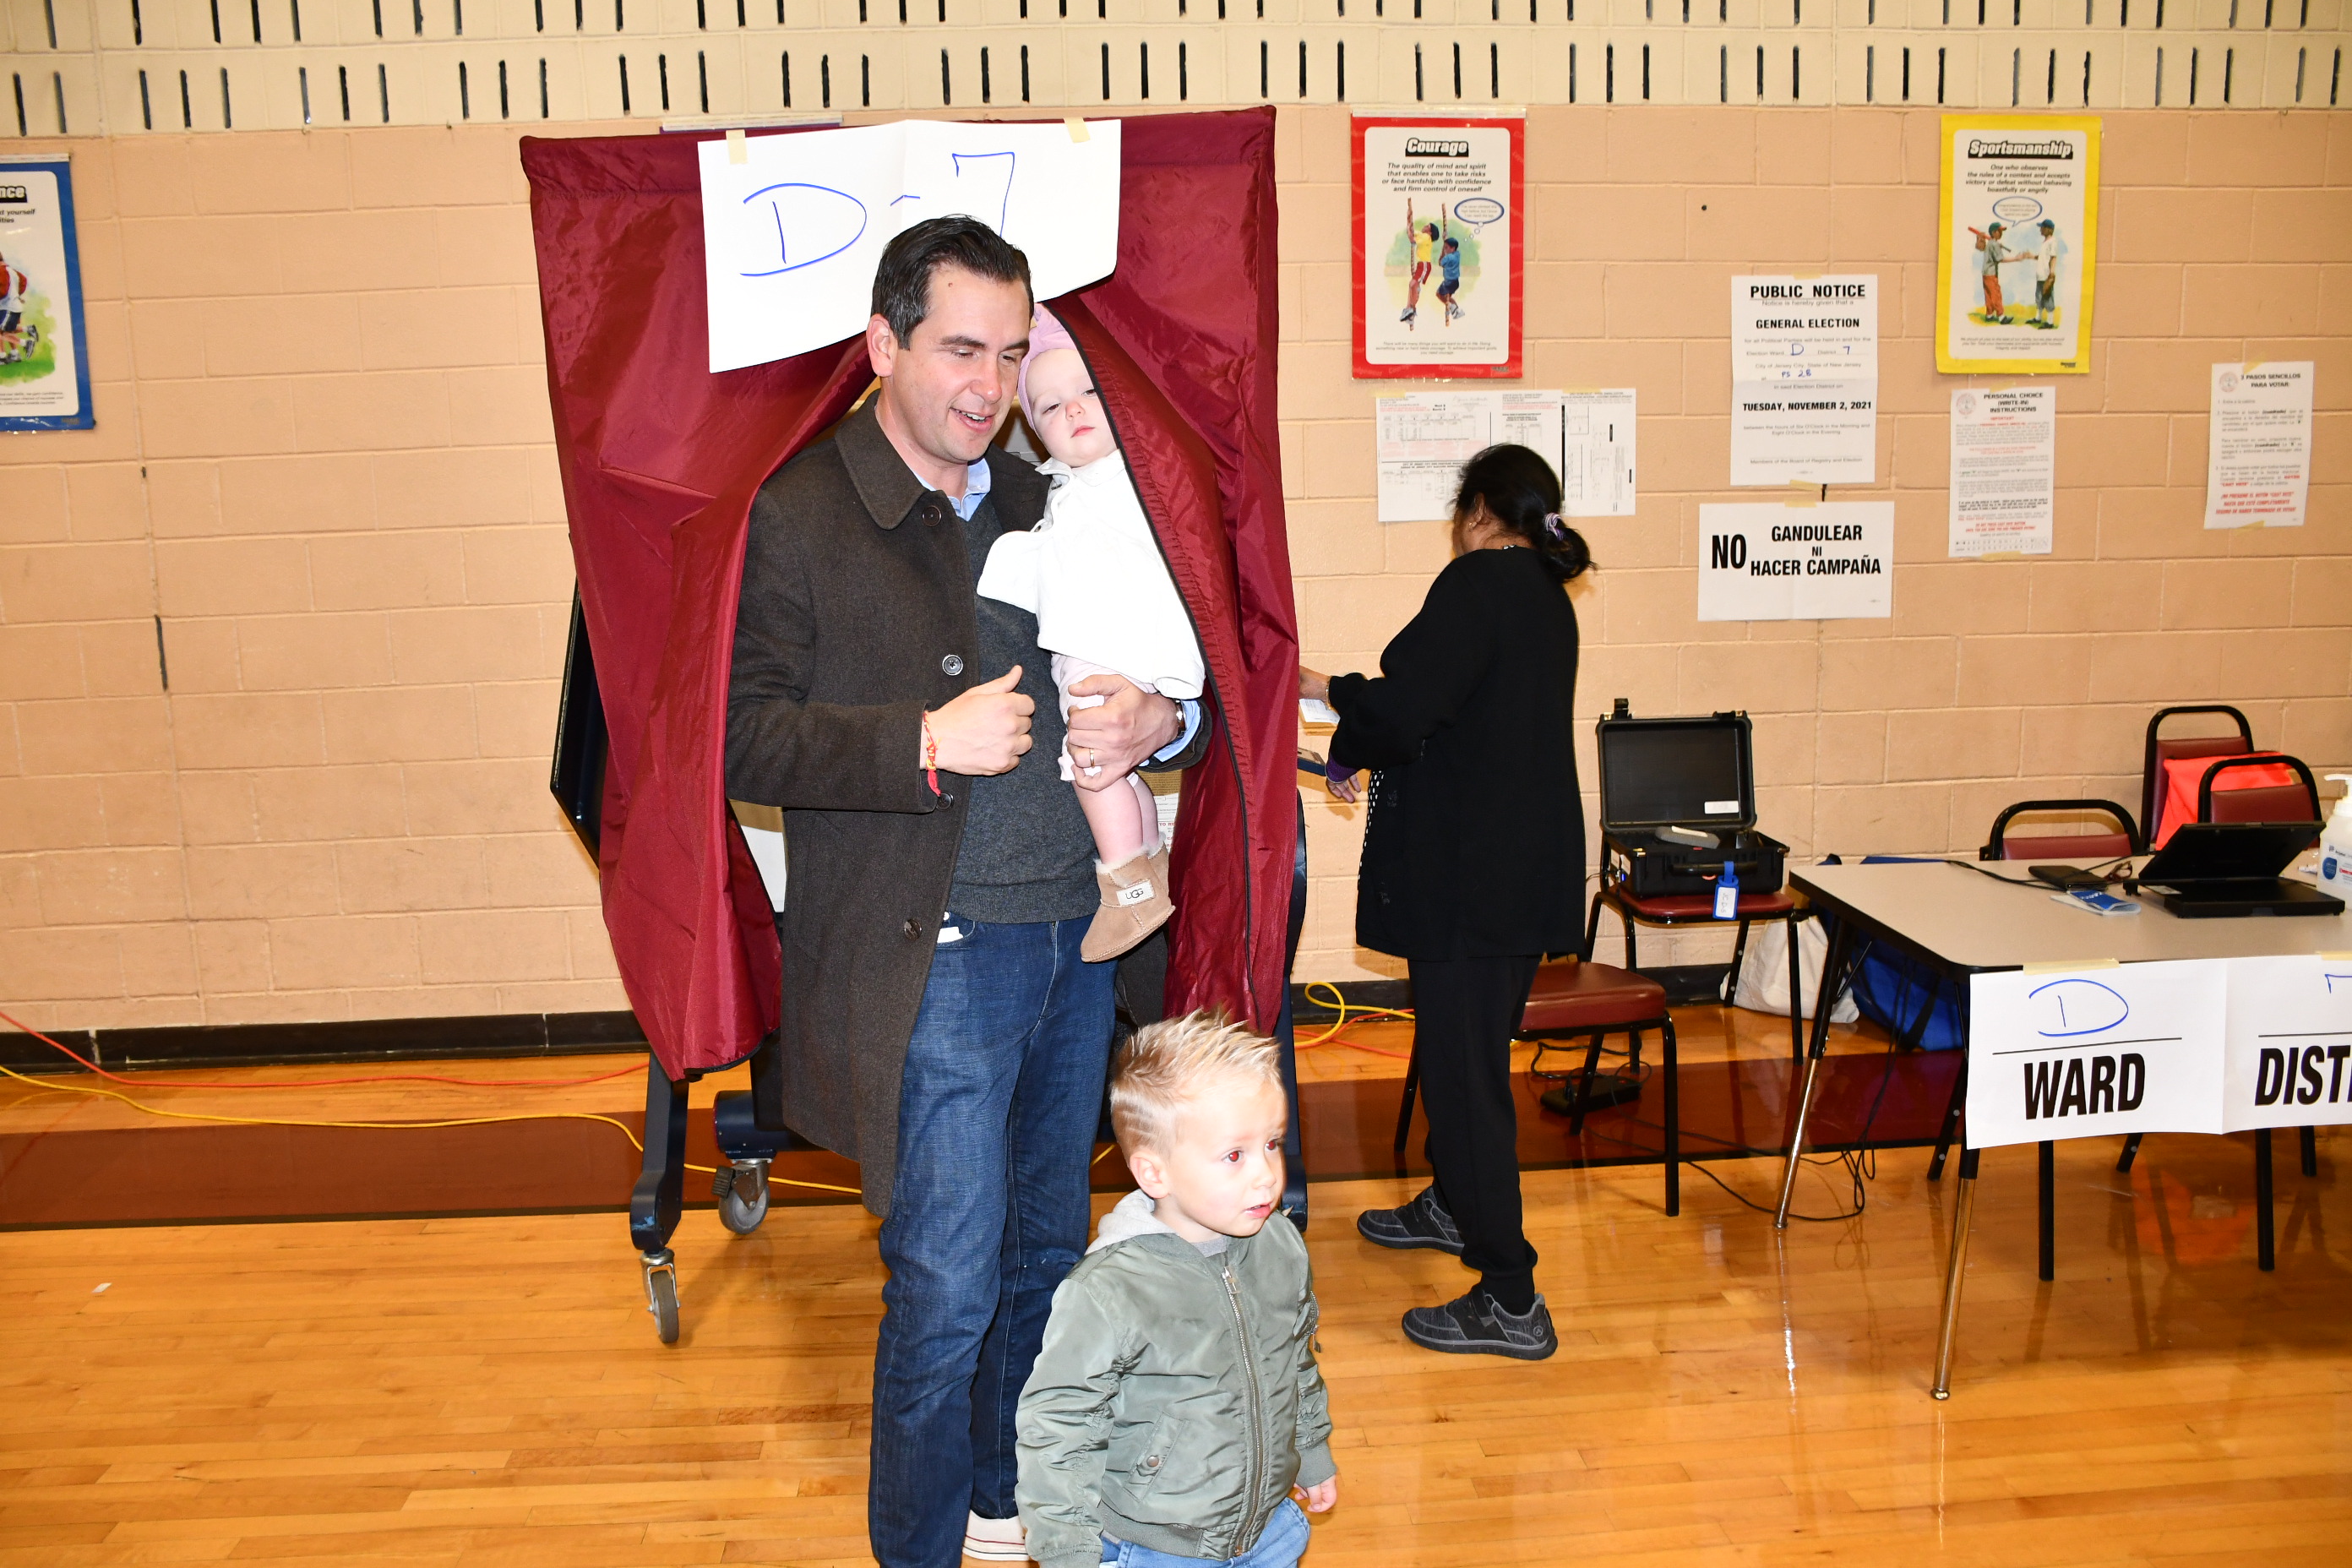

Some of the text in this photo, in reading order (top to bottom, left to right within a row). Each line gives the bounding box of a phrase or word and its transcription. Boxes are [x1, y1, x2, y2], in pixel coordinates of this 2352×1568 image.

[1406, 138, 1468, 156] Courage
[1969, 139, 2072, 158] Sportsmanship
[1750, 284, 1865, 298] PUBLIC NOTICE
[1756, 318, 1859, 329] GENERAL ELECTION
[1790, 343, 1805, 356] D
[1843, 346, 1850, 355] 7
[1743, 401, 1871, 411] TUESDAY, NOVEMBER 2, 2021
[1772, 525, 1862, 542] GANDULEAR
[1712, 534, 1746, 569] NO
[1812, 547, 1821, 556] NI
[1751, 554, 1881, 576] HACER CAMPAÑA
[1125, 888, 1144, 899] UGG
[2029, 979, 2128, 1037] D
[2255, 1045, 2352, 1106] DIST
[2024, 1054, 2145, 1120] WARD
